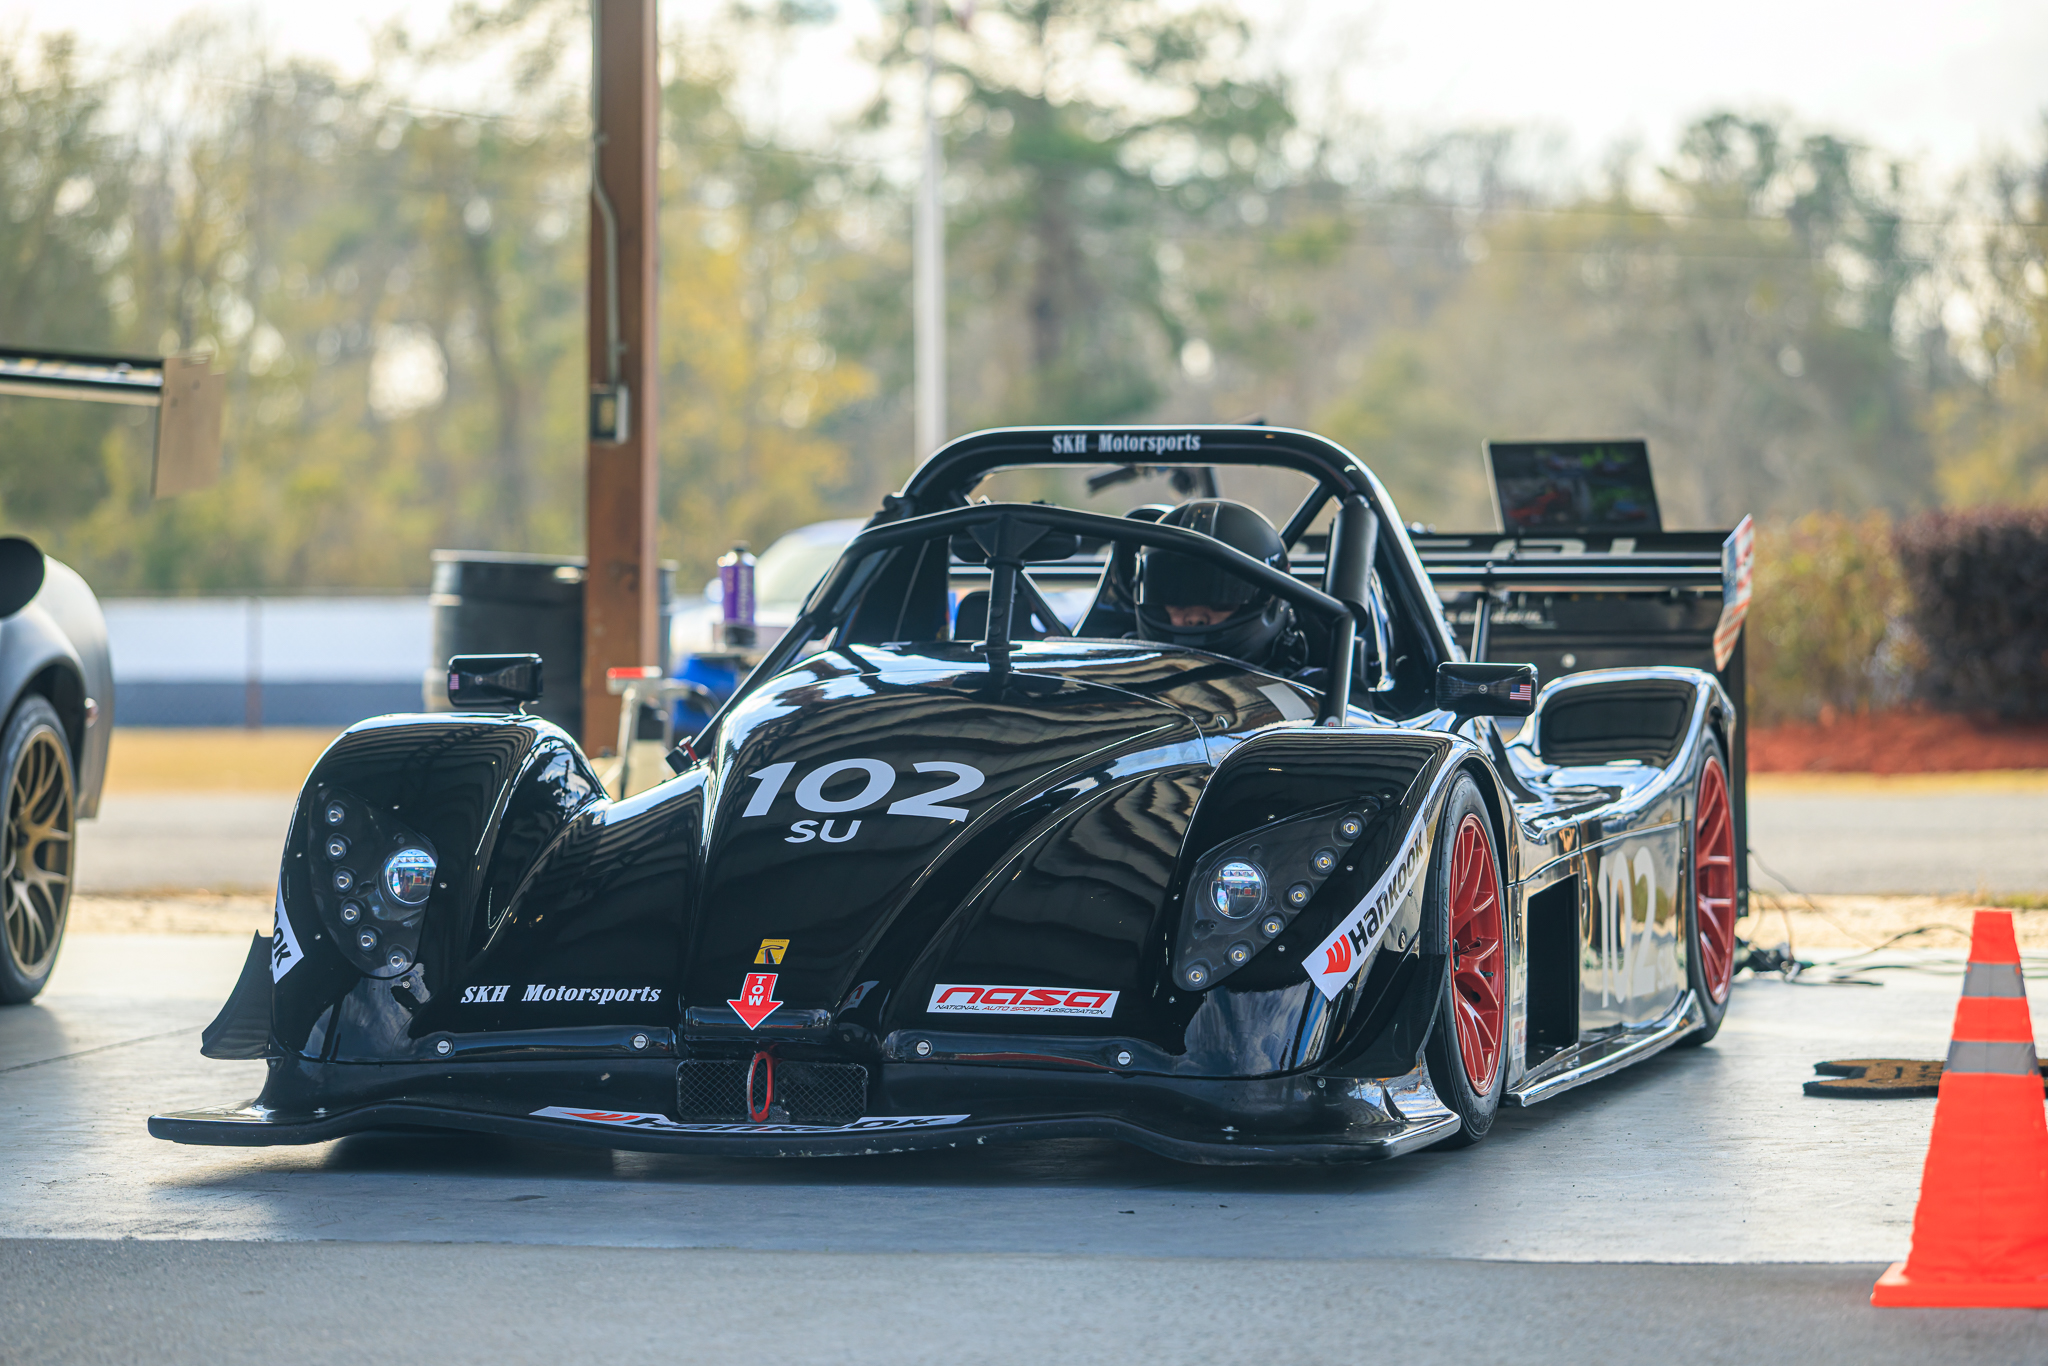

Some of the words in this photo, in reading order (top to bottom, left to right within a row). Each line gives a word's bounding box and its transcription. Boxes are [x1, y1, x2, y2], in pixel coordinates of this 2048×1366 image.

[1052, 434, 1087, 454] SKH
[1098, 433, 1201, 455] Motorsports
[742, 758, 985, 823] 102
[784, 819, 862, 843] SU
[1348, 830, 1424, 957] Hankook
[1597, 846, 1656, 1008] 102
[460, 985, 510, 1003] SKH
[521, 984, 662, 1005] Motorsports
[748, 975, 767, 1006] TOW
